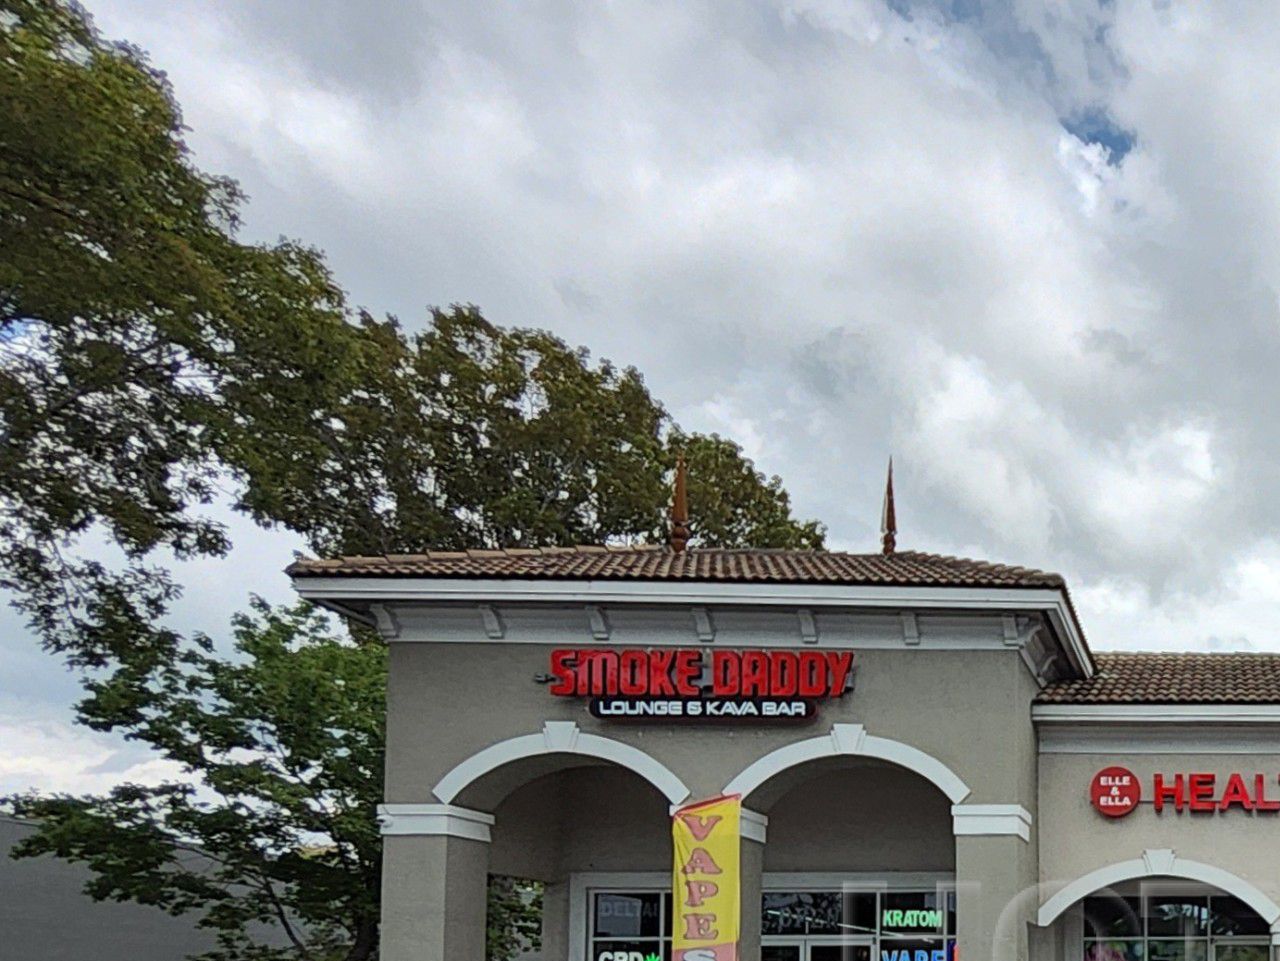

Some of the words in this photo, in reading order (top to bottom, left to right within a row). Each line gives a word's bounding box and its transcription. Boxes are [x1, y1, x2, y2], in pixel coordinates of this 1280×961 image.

[550, 649, 700, 697] SMOKE
[712, 650, 854, 698] DADDY
[599, 701, 682, 715] LOUNGE
[706, 701, 758, 716] KAVA
[762, 702, 805, 716] BAR
[1100, 776, 1130, 785] ELLE
[1100, 796, 1131, 806] ELLA
[680, 814, 722, 941] VAPE
[882, 909, 943, 928] KRATOM
